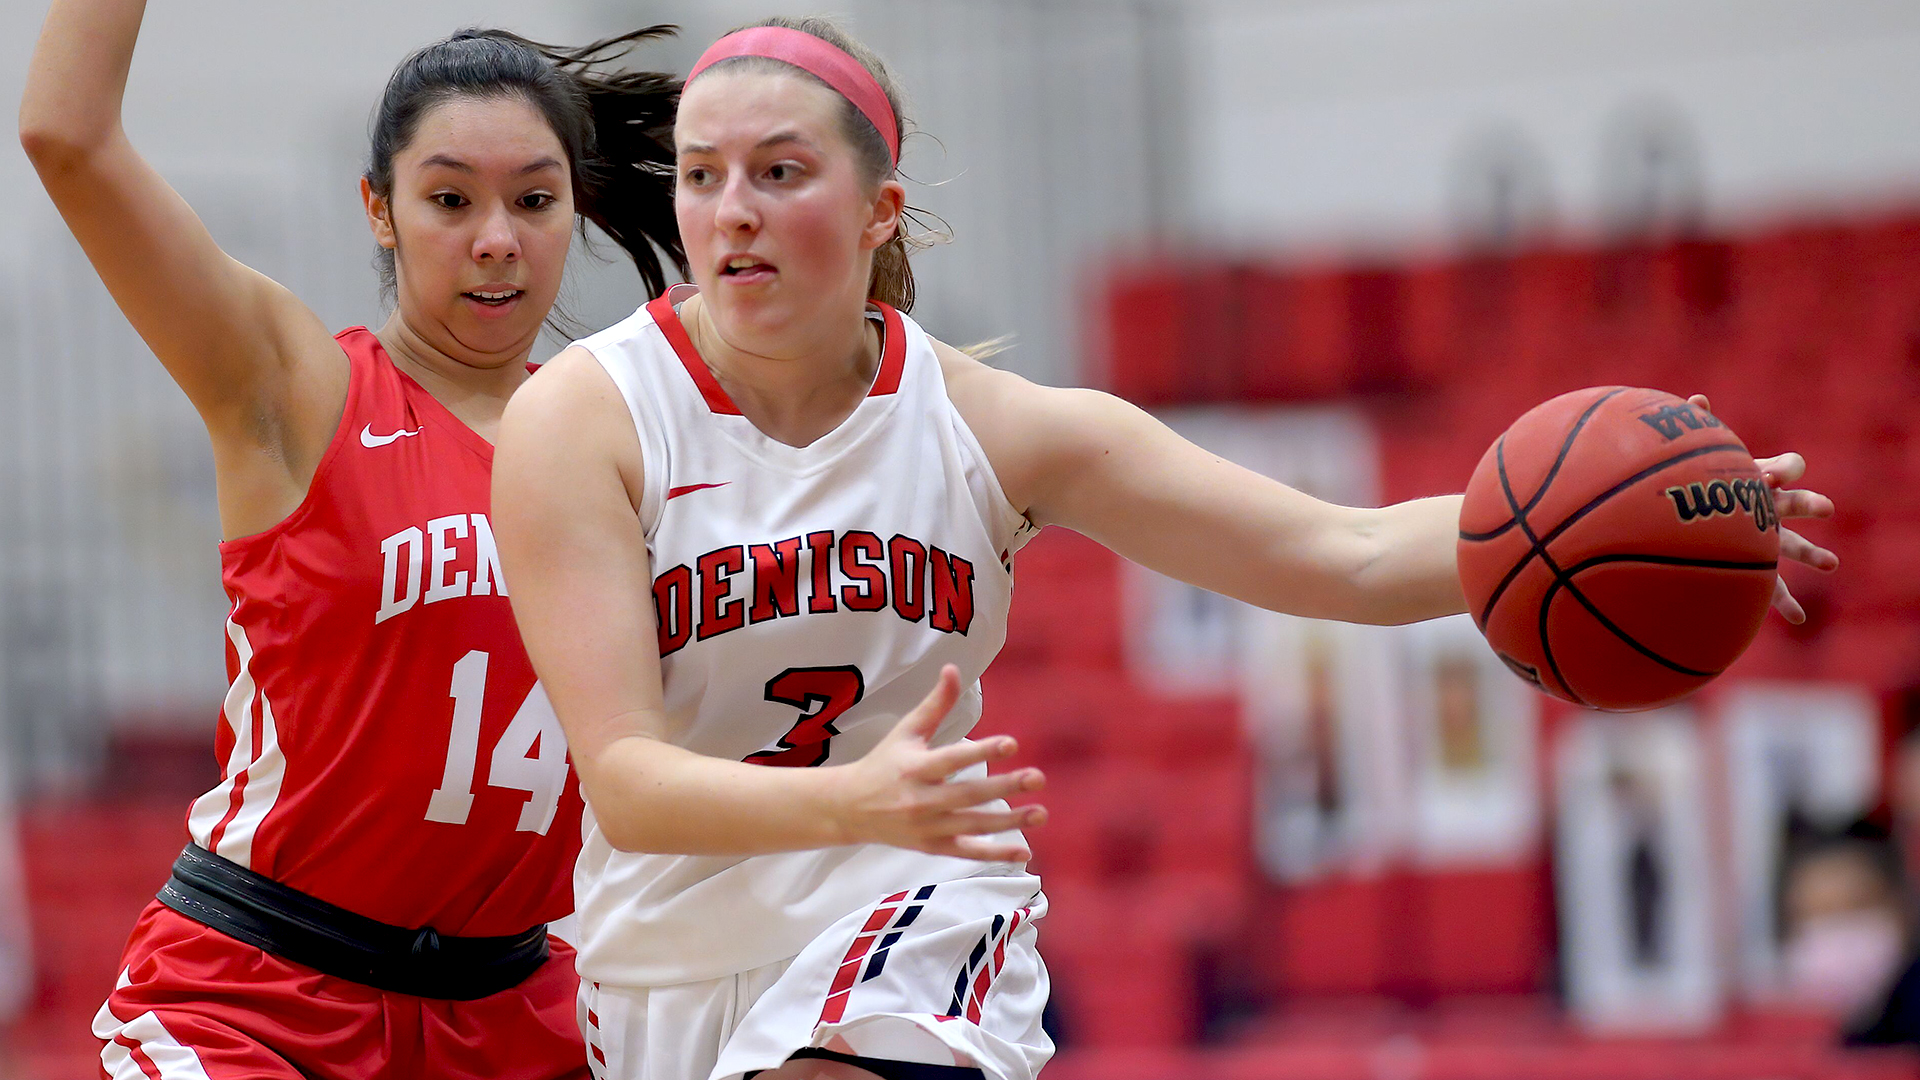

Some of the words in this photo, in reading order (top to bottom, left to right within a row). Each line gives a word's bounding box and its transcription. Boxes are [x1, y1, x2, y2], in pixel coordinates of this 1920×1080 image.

[1665, 477, 1778, 533] ilson
[375, 513, 509, 625] DEN
[653, 530, 976, 659] DENISON
[424, 650, 570, 836] 14
[741, 664, 865, 767] 3
